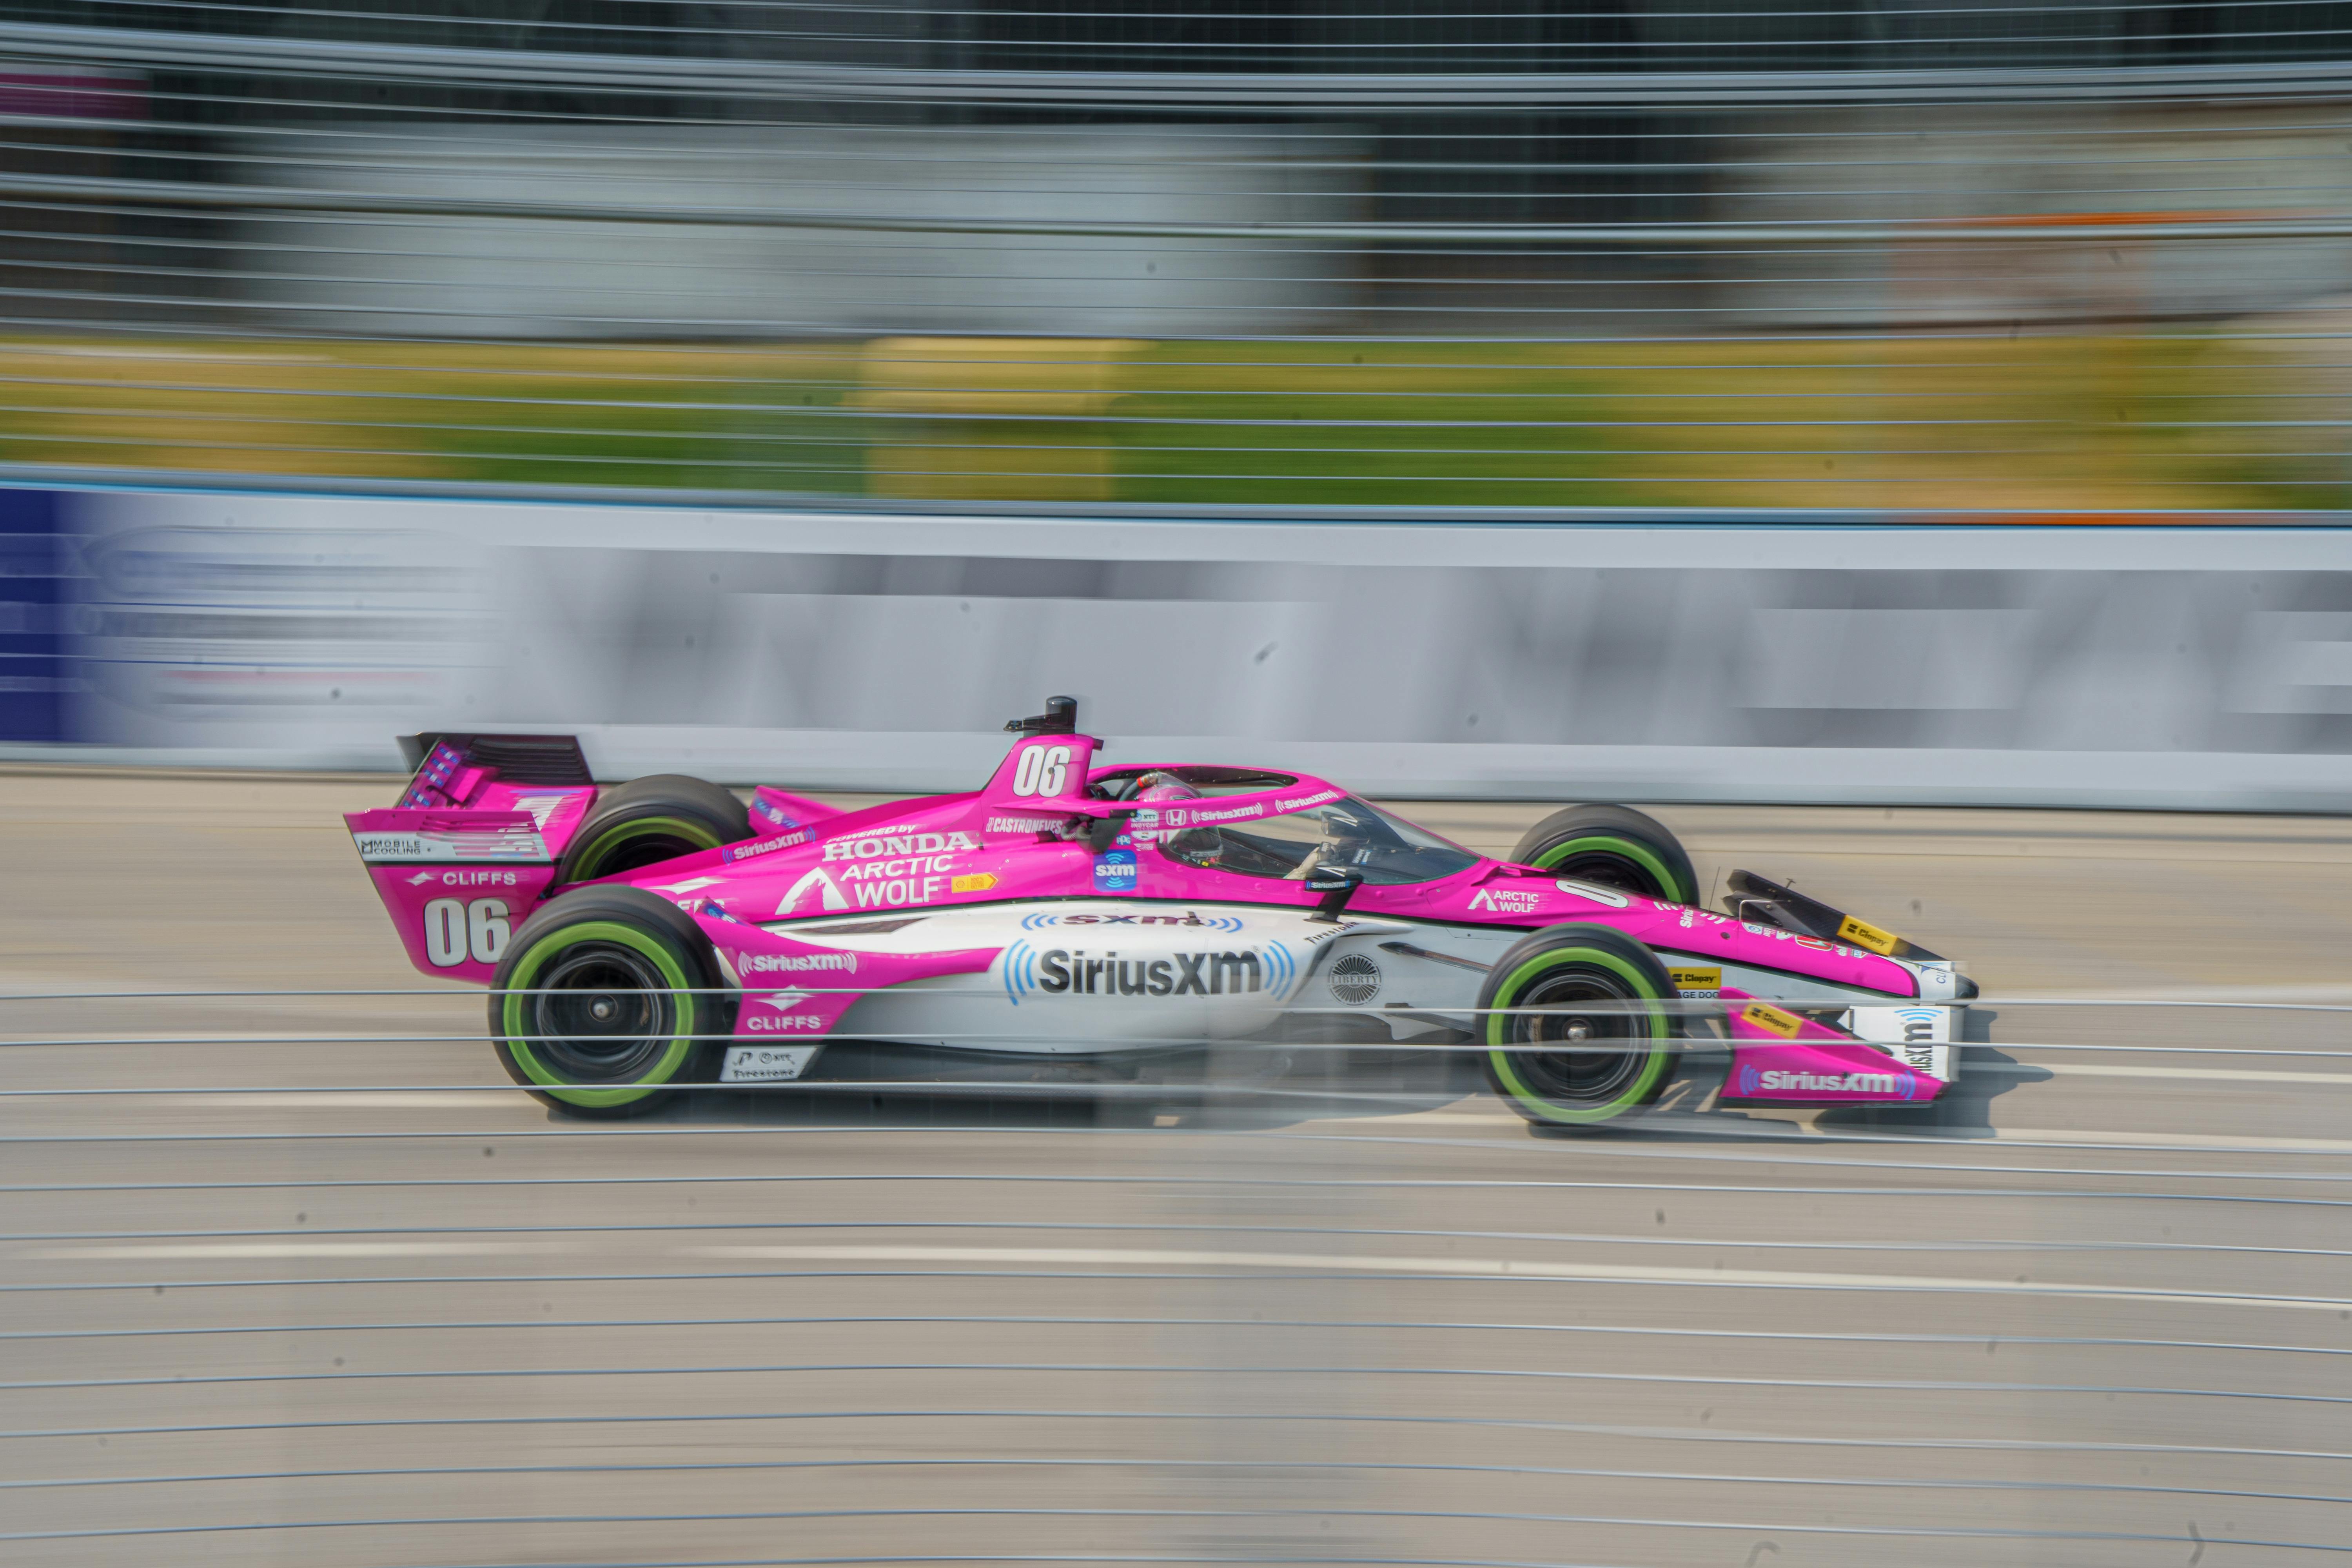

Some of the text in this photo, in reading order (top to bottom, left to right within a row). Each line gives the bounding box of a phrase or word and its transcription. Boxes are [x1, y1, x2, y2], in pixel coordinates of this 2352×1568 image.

[1013, 745, 1071, 798] 06
[826, 824, 916, 844] POWERED by
[993, 817, 1063, 834] CASTRONEVES
[822, 831, 977, 862] HONDA
[840, 855, 953, 882] ARCTIC
[1095, 864, 1135, 877] sxm
[443, 871, 517, 886] CLIFFS
[854, 877, 941, 908] WOLF
[1494, 890, 1539, 903] ARCTIC
[1499, 902, 1535, 913] WOLF
[1679, 906, 1694, 928] Siriu
[423, 898, 510, 967] 06
[1304, 922, 1359, 945] Firestone
[1858, 929, 1887, 947] Clopay
[1331, 976, 1379, 984] LIBERTY
[1684, 974, 1715, 984] Clopay
[1936, 970, 1946, 984] CLI
[746, 1015, 822, 1031] CLIFFS
[1764, 1013, 1793, 1031] Clopay
